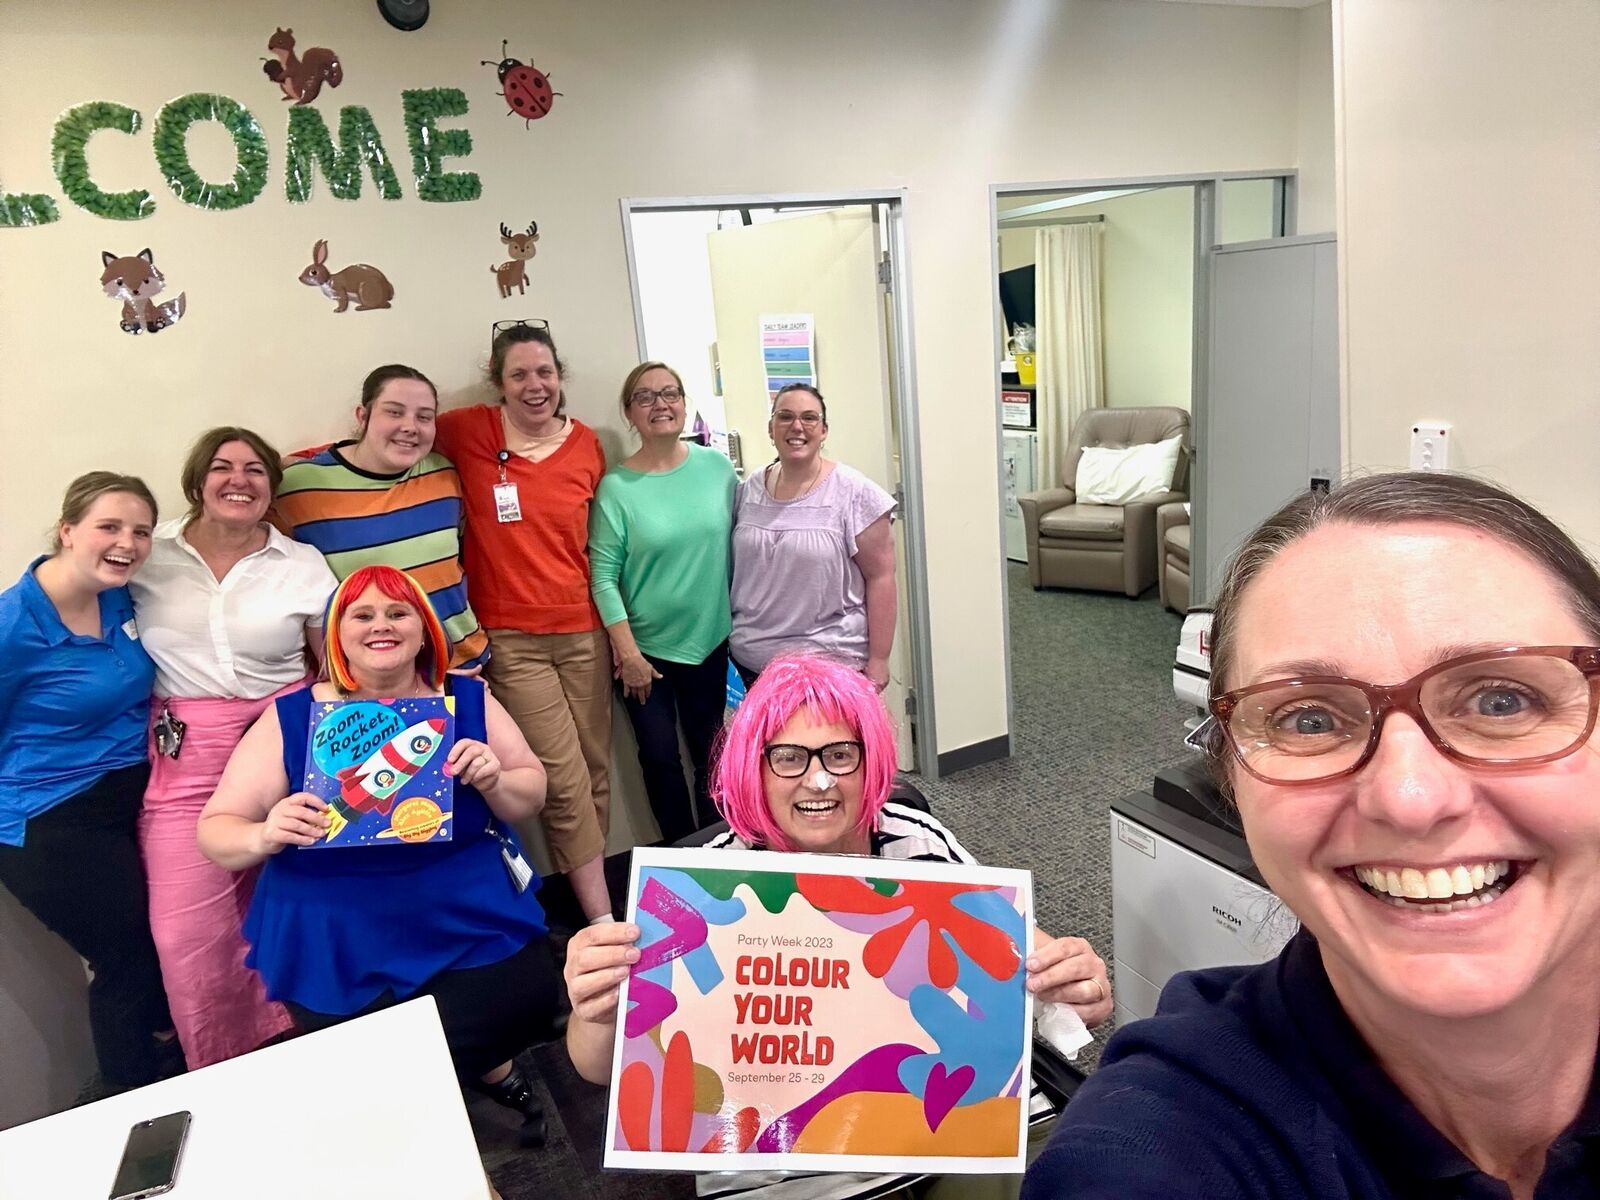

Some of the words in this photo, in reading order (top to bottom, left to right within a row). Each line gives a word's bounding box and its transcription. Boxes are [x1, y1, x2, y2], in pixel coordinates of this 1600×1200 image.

[351, 715, 400, 761] Zoom!
[1212, 905, 1242, 926] RICOH
[737, 934, 768, 948] Party
[771, 935, 802, 947] Week
[805, 937, 833, 948] 2023
[735, 952, 850, 989] COLOUR
[733, 992, 813, 1026] YOUR
[731, 1031, 835, 1066] WORLD
[727, 1072, 786, 1085] September
[788, 1073, 801, 1083] 25
[811, 1073, 825, 1084] 29
